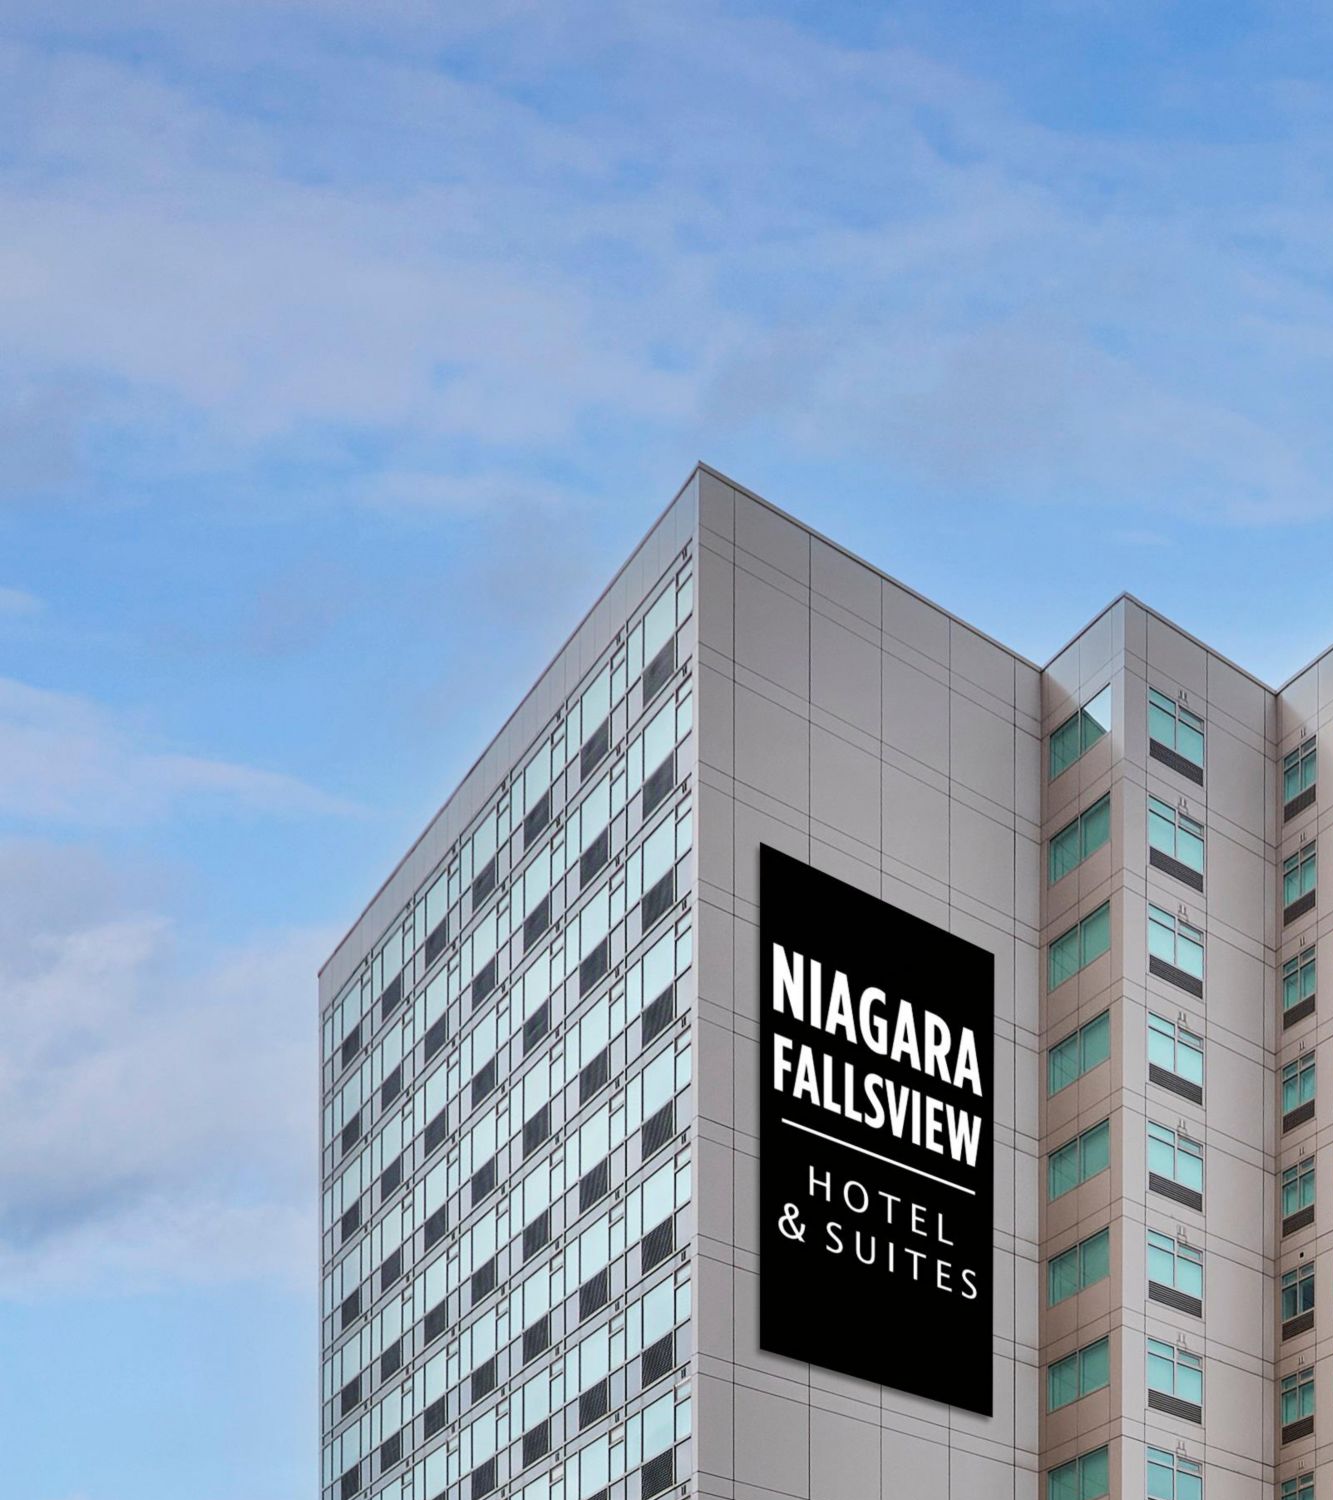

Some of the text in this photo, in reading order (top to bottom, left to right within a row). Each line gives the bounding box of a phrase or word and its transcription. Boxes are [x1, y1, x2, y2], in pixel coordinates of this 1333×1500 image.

[773, 943, 982, 1097] NIAGARA
[773, 1033, 982, 1168] FALLSVIEW
[778, 1202, 978, 1300] & SUITES
[809, 1165, 954, 1246] HOTEL
